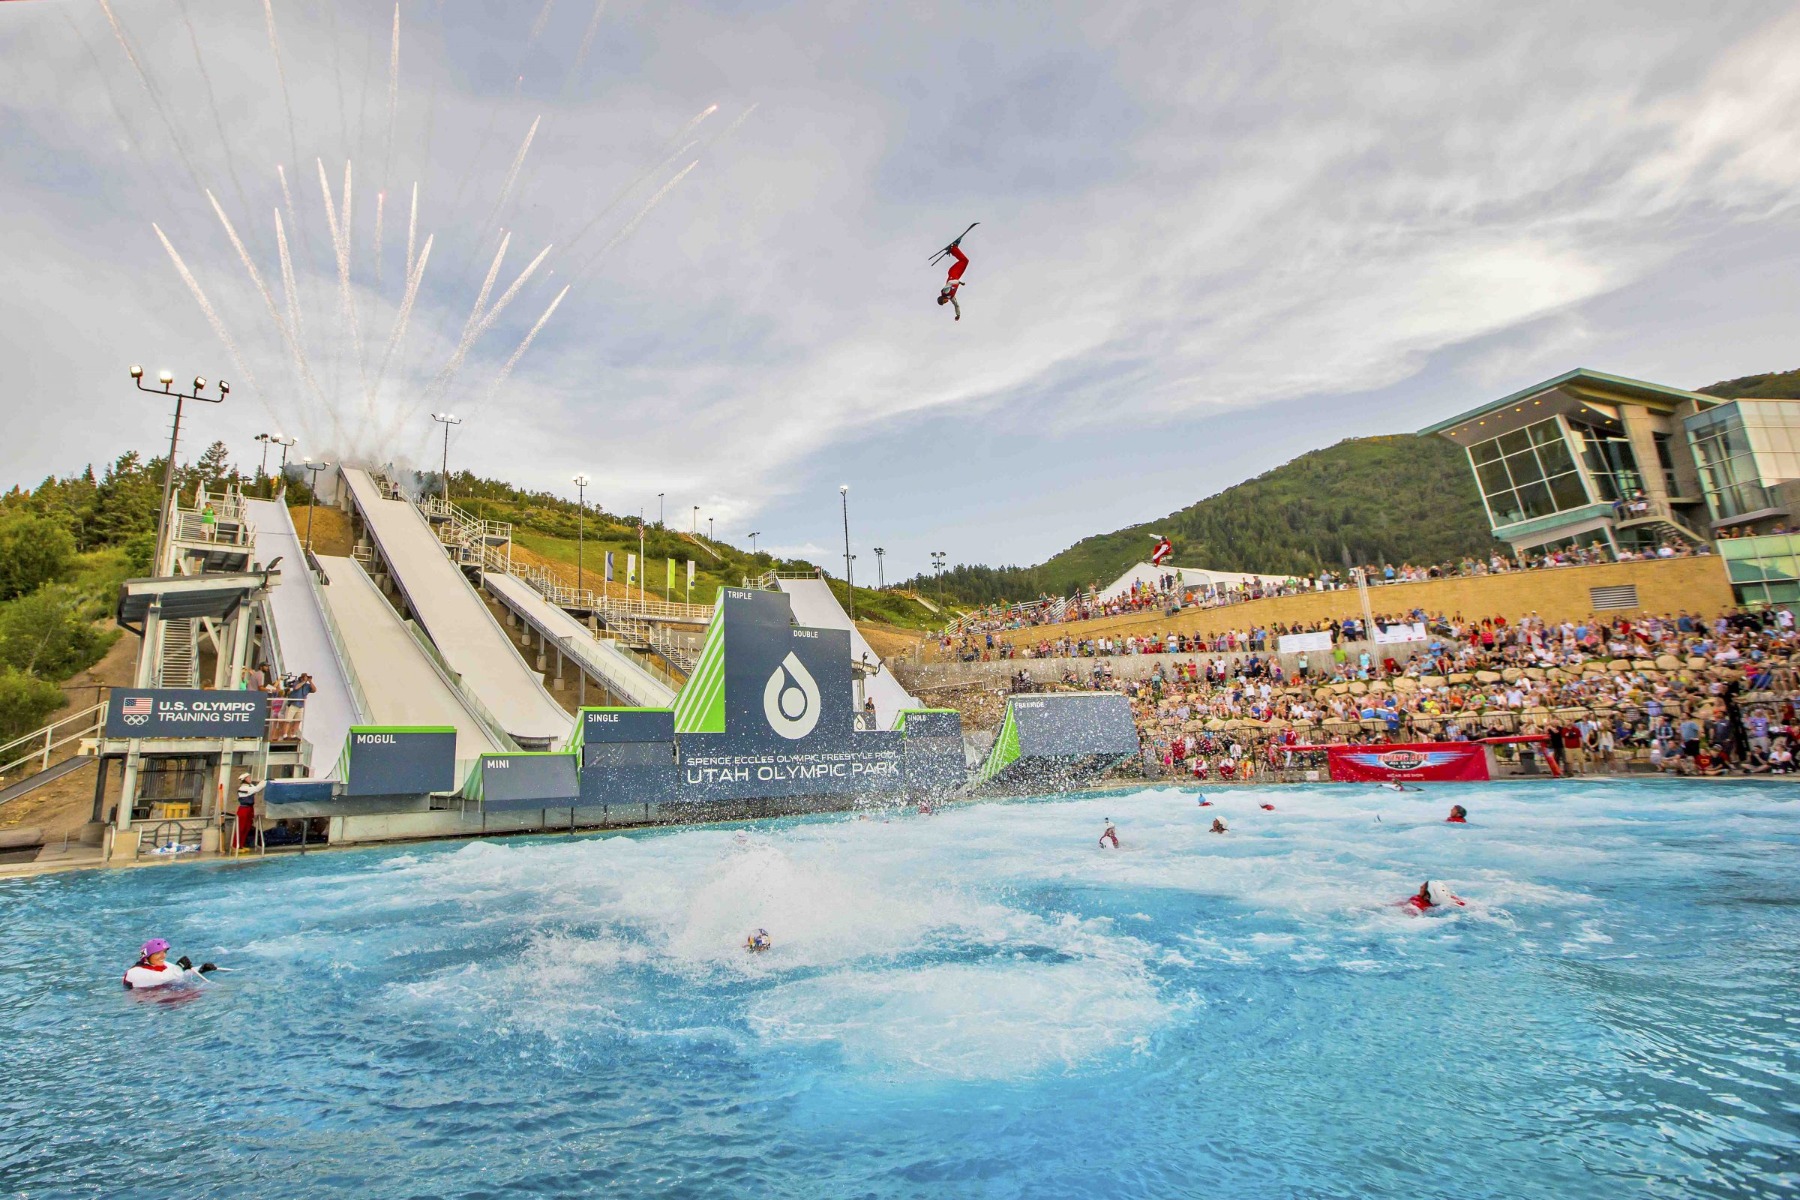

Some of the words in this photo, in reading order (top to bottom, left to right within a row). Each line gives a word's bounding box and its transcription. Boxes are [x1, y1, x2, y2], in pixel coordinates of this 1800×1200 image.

[728, 591, 752, 600] TRIPLE
[793, 630, 819, 638] DOUBLE
[159, 702, 188, 711] U.S.
[192, 702, 255, 711] OLYMPIC
[158, 712, 220, 722] TRAINING
[223, 713, 250, 722] SITE
[587, 713, 619, 723] SINGLE
[356, 734, 397, 745] MOGUL
[734, 755, 775, 764] ECCLES
[776, 754, 819, 762] OLYMPIC
[821, 752, 873, 761] FREESTYLE
[487, 759, 510, 769] MINI
[687, 767, 749, 784] UTAH
[757, 764, 846, 781] OLYMPIC
[852, 761, 899, 776] PARK
